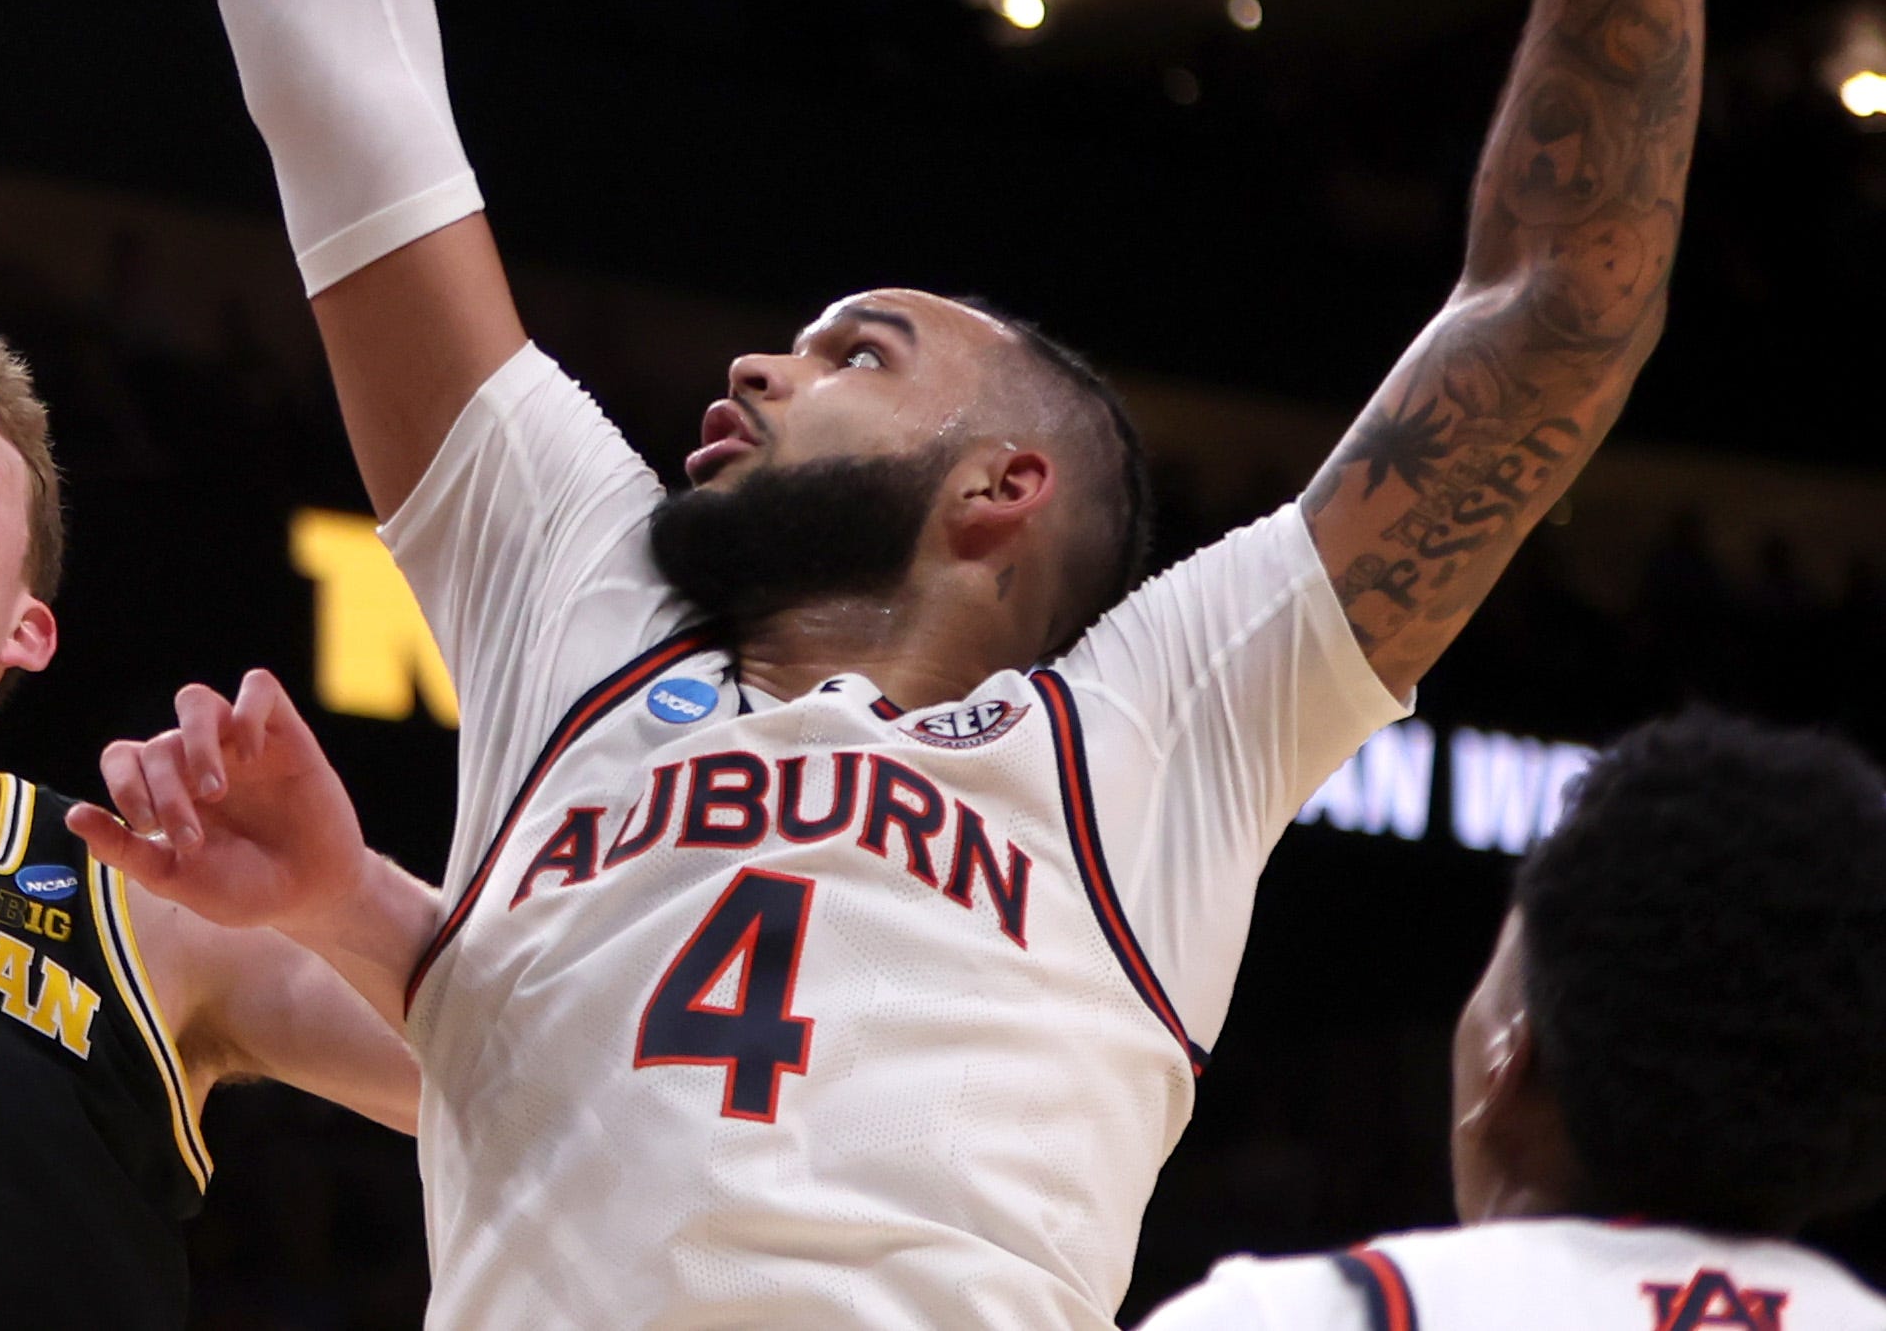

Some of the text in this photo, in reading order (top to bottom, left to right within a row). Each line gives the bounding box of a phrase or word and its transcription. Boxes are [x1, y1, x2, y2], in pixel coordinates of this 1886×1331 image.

[653, 690, 706, 717] NCAA
[922, 703, 1004, 738] SEC
[509, 750, 1033, 951] AUBURN
[25, 877, 79, 892] NCAA
[632, 867, 817, 1124] 4
